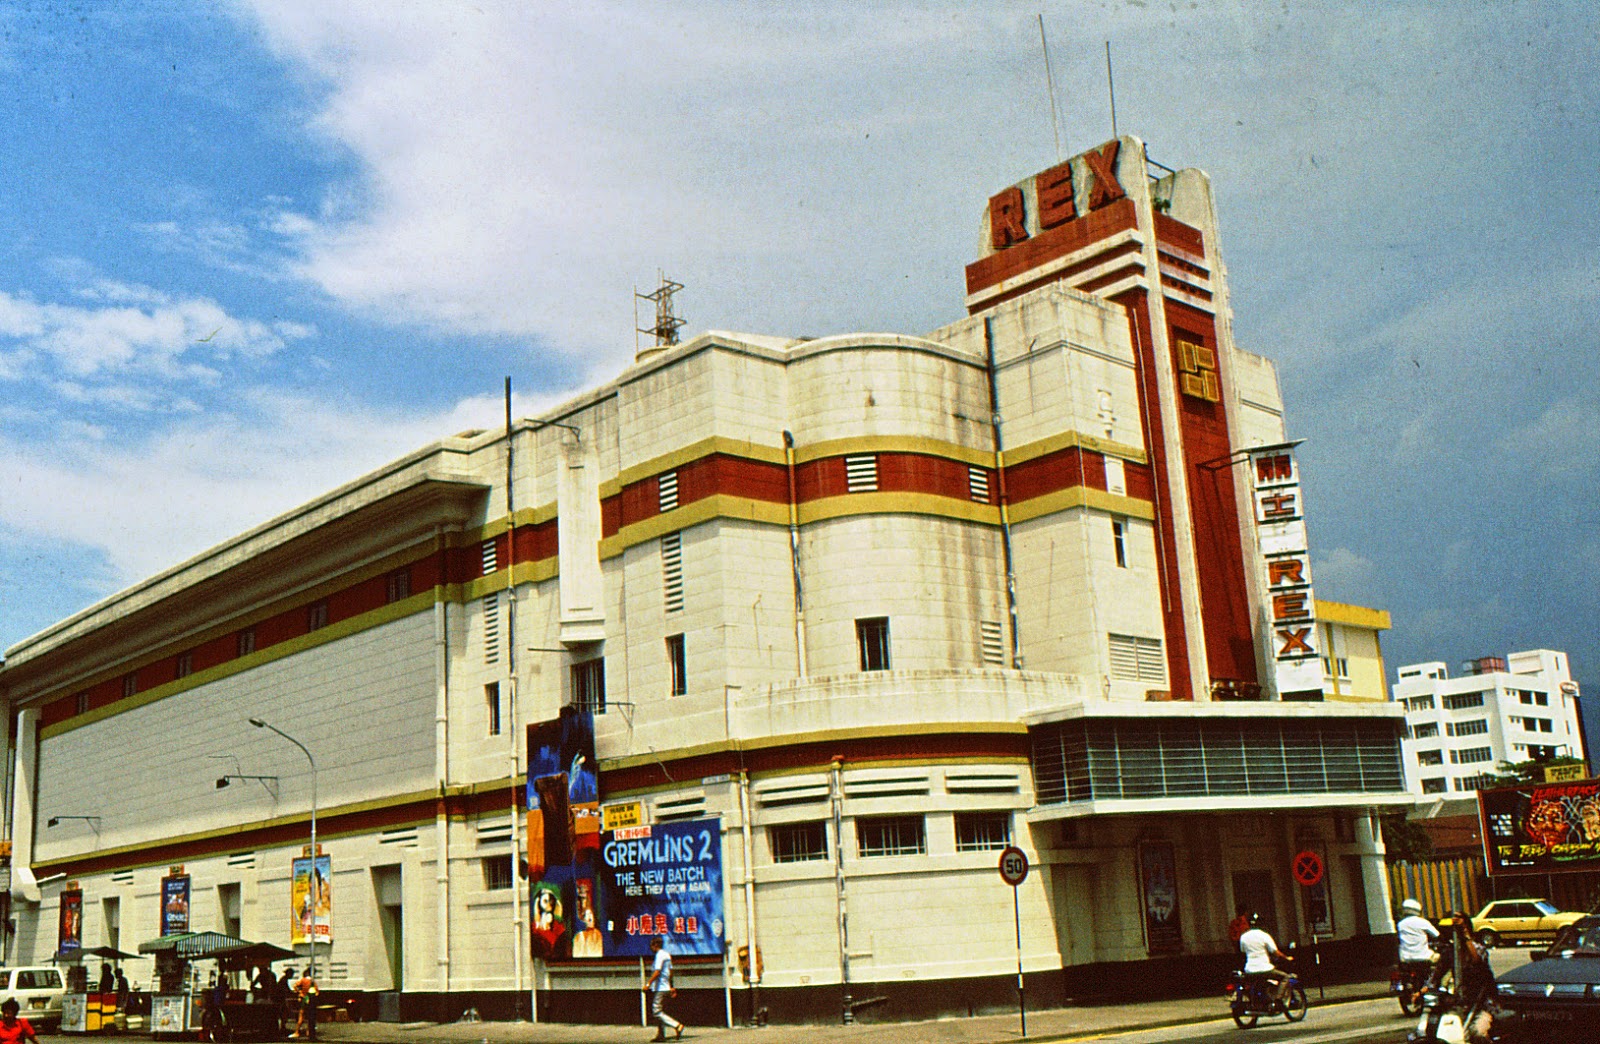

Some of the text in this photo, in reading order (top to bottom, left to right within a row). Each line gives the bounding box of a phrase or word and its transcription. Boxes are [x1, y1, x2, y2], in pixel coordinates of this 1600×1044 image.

[988, 139, 1128, 250] REX
[1268, 559, 1315, 655] REX
[698, 829, 713, 861] 2
[615, 865, 705, 886] THE NEW BATCH
[1006, 858, 1022, 874] 50
[625, 885, 643, 896] HERE
[645, 884, 664, 895] THEY
[665, 883, 687, 895] GROW
